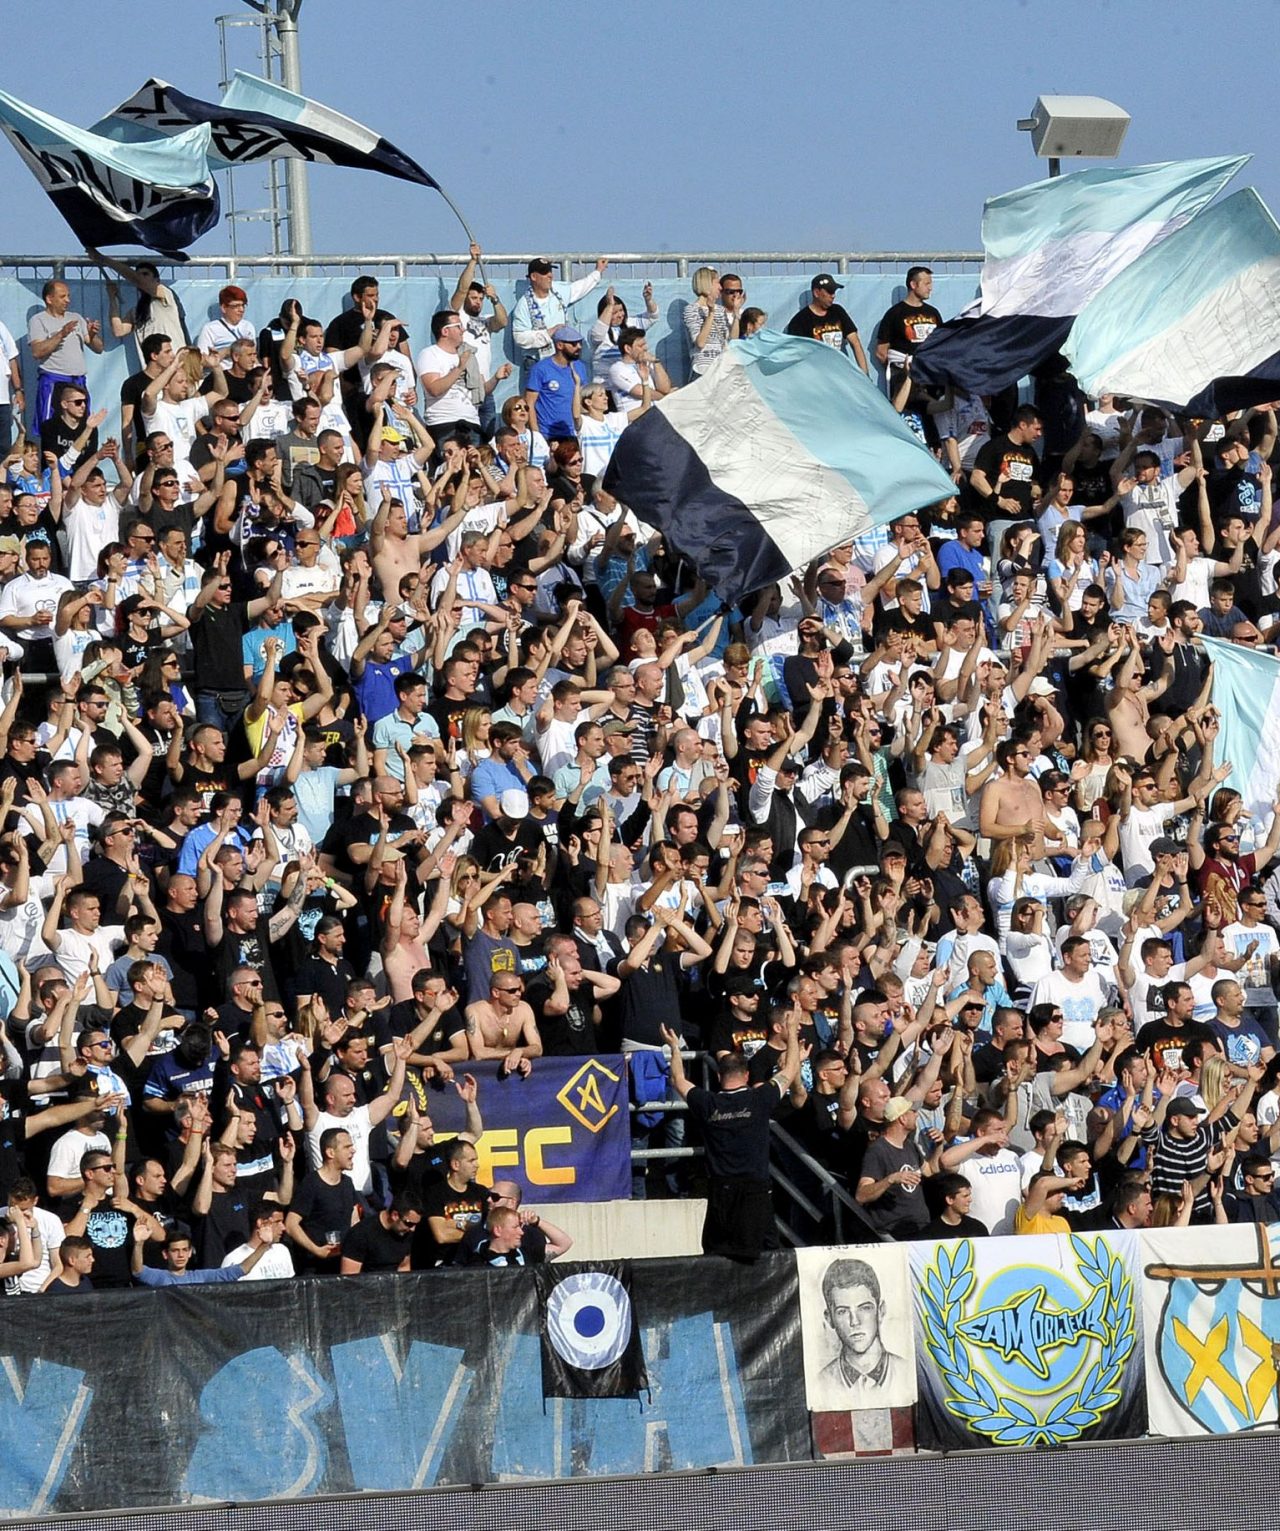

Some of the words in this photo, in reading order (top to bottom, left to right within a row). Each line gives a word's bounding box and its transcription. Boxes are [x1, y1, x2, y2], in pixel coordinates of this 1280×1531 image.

[433, 1126, 577, 1190] FC
[979, 1163, 1018, 1175] adidas
[957, 1297, 1107, 1363] SAMORIJEKA
